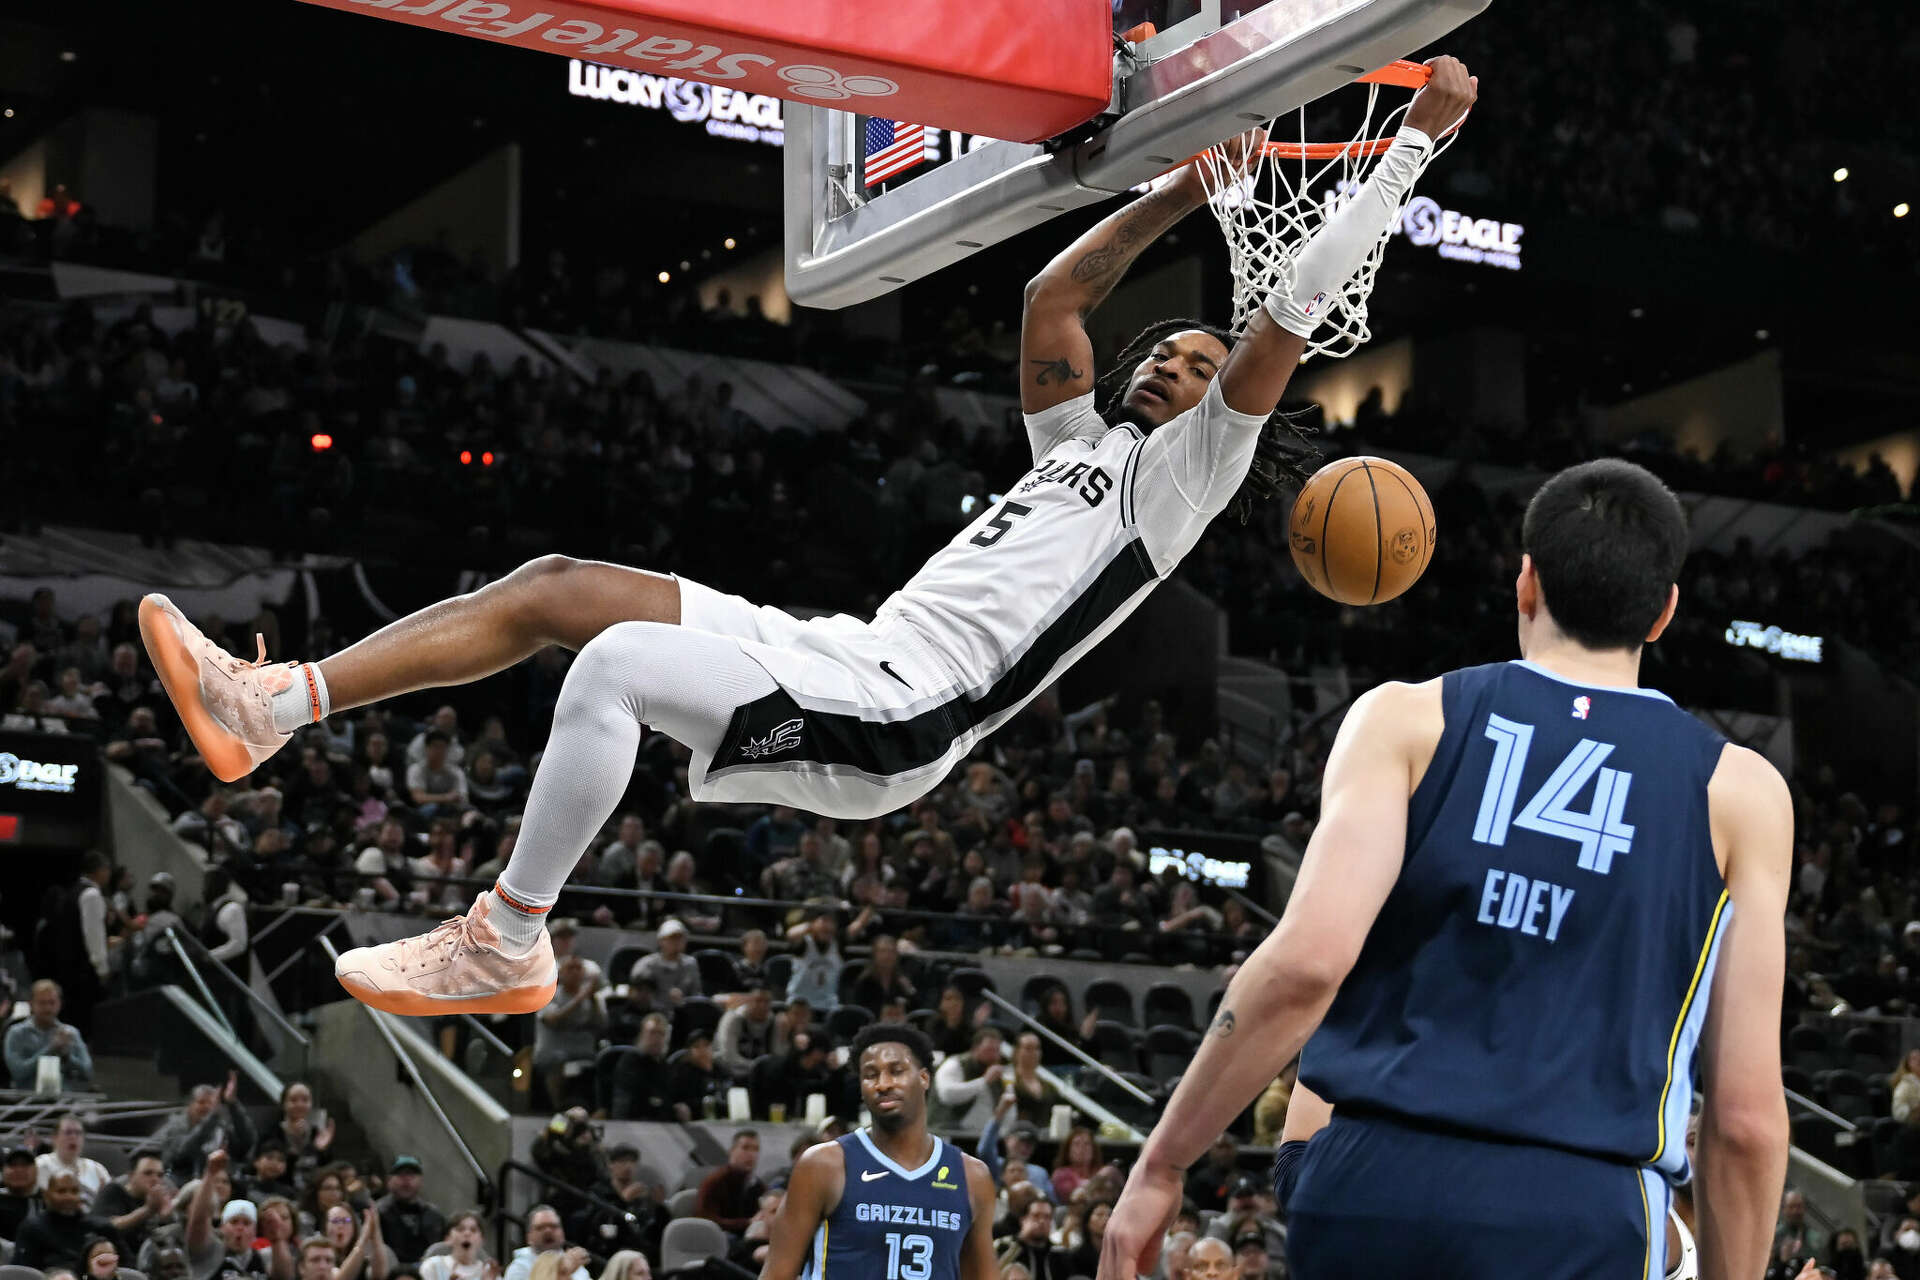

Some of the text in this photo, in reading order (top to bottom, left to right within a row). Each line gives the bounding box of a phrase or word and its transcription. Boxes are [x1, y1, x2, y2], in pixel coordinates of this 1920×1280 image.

[568, 58, 785, 129] LUCKY EAGL
[1441, 209, 1524, 254] EAGLE
[968, 500, 1034, 549] 5
[1472, 712, 1636, 875] 14
[1477, 868, 1576, 943] EDEY
[855, 1203, 961, 1231] GRIZZLIES
[885, 1232, 934, 1280] 13
